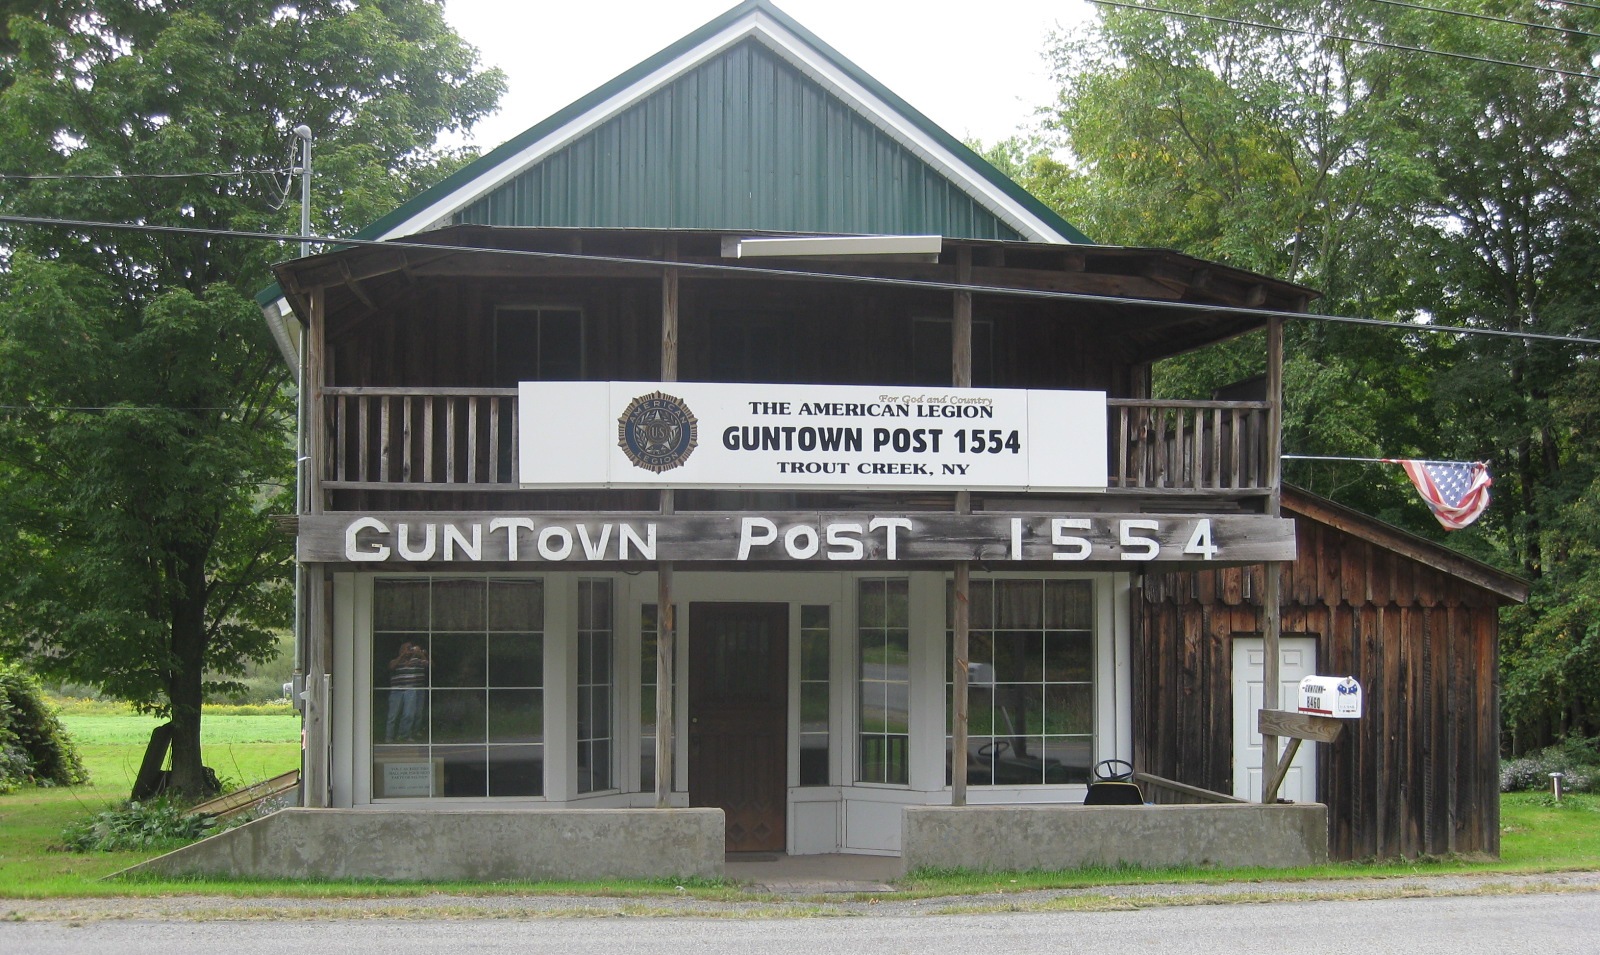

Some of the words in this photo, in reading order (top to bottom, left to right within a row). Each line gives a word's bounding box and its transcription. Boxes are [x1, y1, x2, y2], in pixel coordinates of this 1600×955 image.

[879, 394, 899, 403] For
[902, 394, 925, 405] God
[926, 394, 949, 404] and
[949, 395, 993, 407] Country
[629, 400, 688, 424] AMERICAN
[748, 401, 791, 415] THE
[798, 402, 910, 417] AMERICAN
[917, 404, 994, 419] LEGION
[722, 425, 863, 452] GUNTOWN
[873, 427, 943, 454] POST
[953, 429, 1021, 455] 1554
[636, 451, 679, 465] LEGION
[776, 461, 850, 474] TROUT
[857, 463, 935, 477] CREEK,
[941, 463, 970, 476] NY
[344, 516, 658, 563] GUNTOWN
[736, 516, 914, 562] POST
[1010, 516, 1220, 562] 1554
